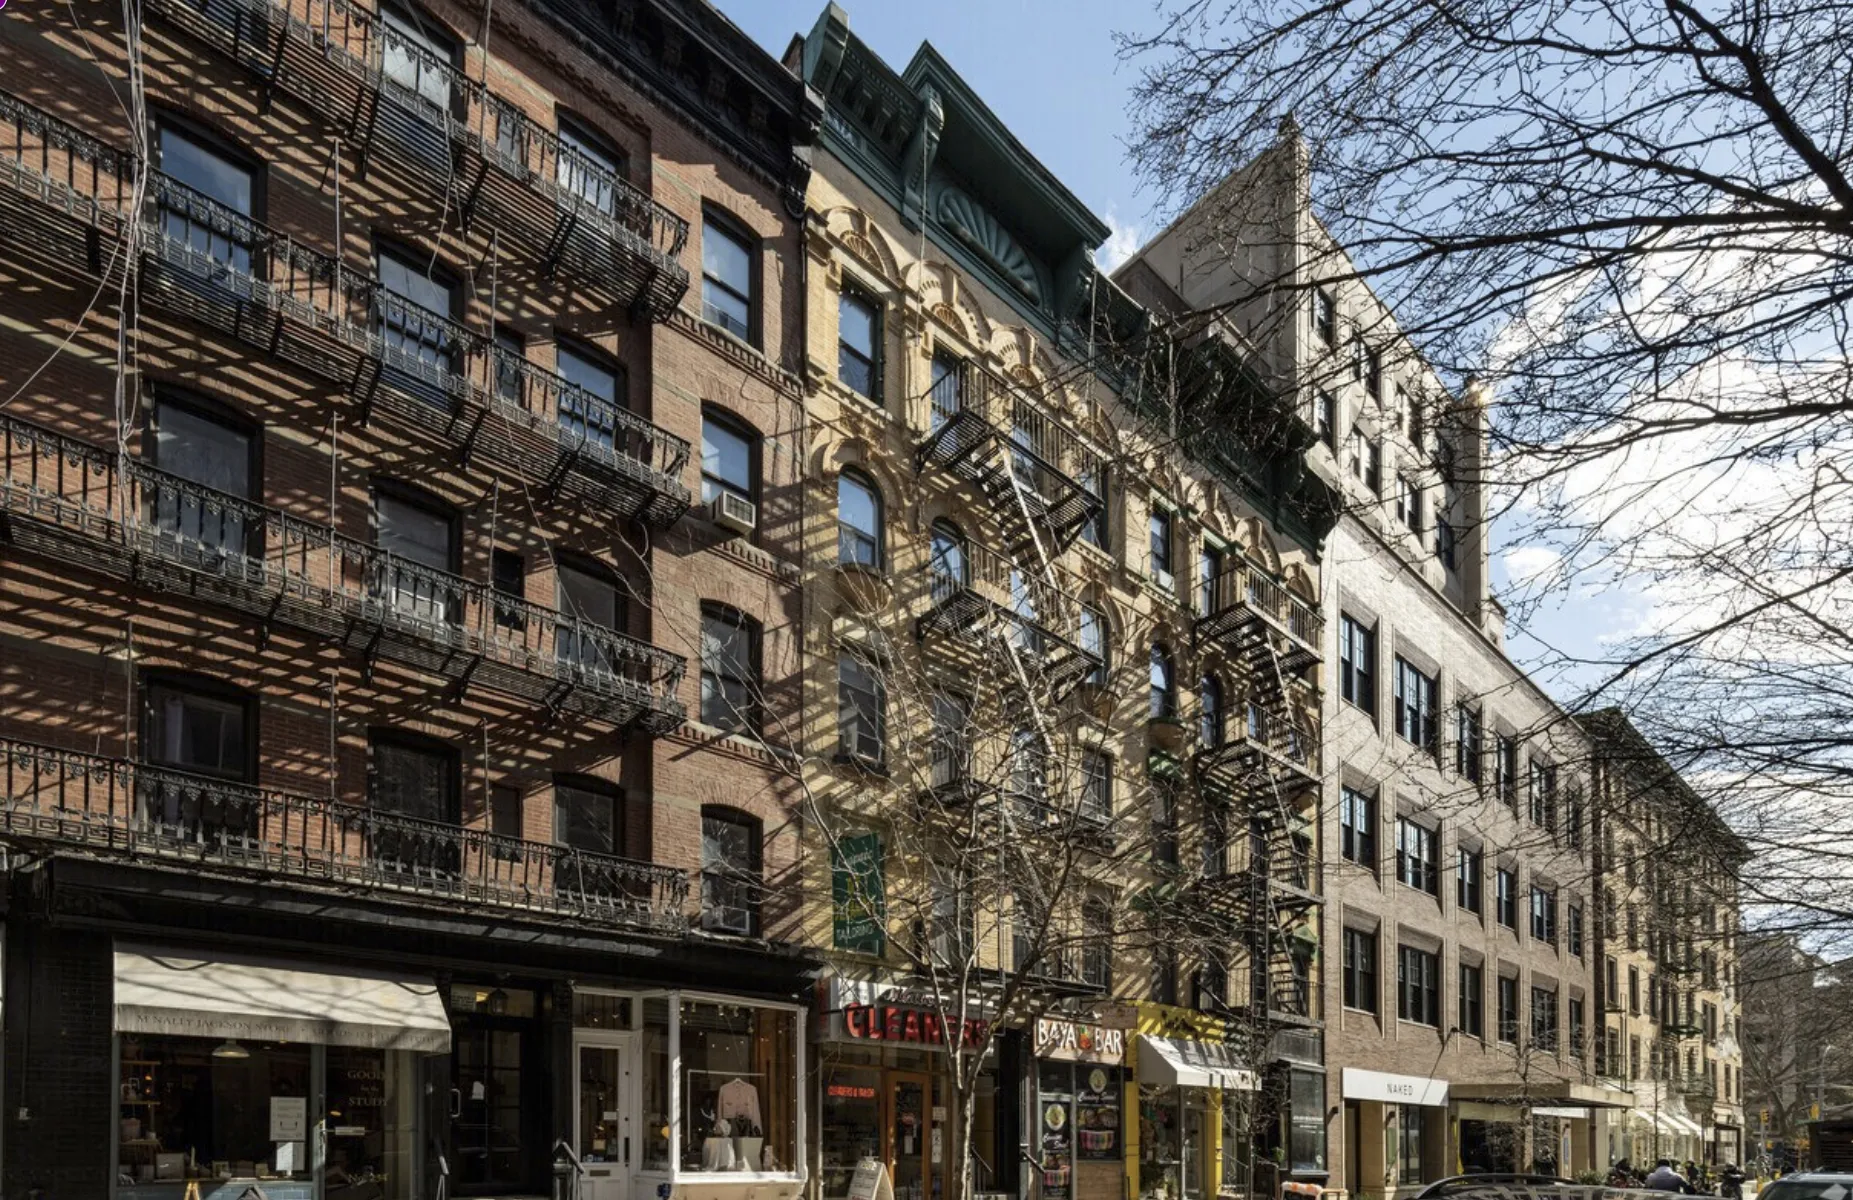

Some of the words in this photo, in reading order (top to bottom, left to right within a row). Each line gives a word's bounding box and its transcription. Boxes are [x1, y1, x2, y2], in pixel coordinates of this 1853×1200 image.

[846, 1002, 989, 1048] CLEANERS
[1038, 1019, 1077, 1049] BAYA
[1095, 1027, 1122, 1055] BAR
[1386, 1083, 1414, 1096] NAKED
